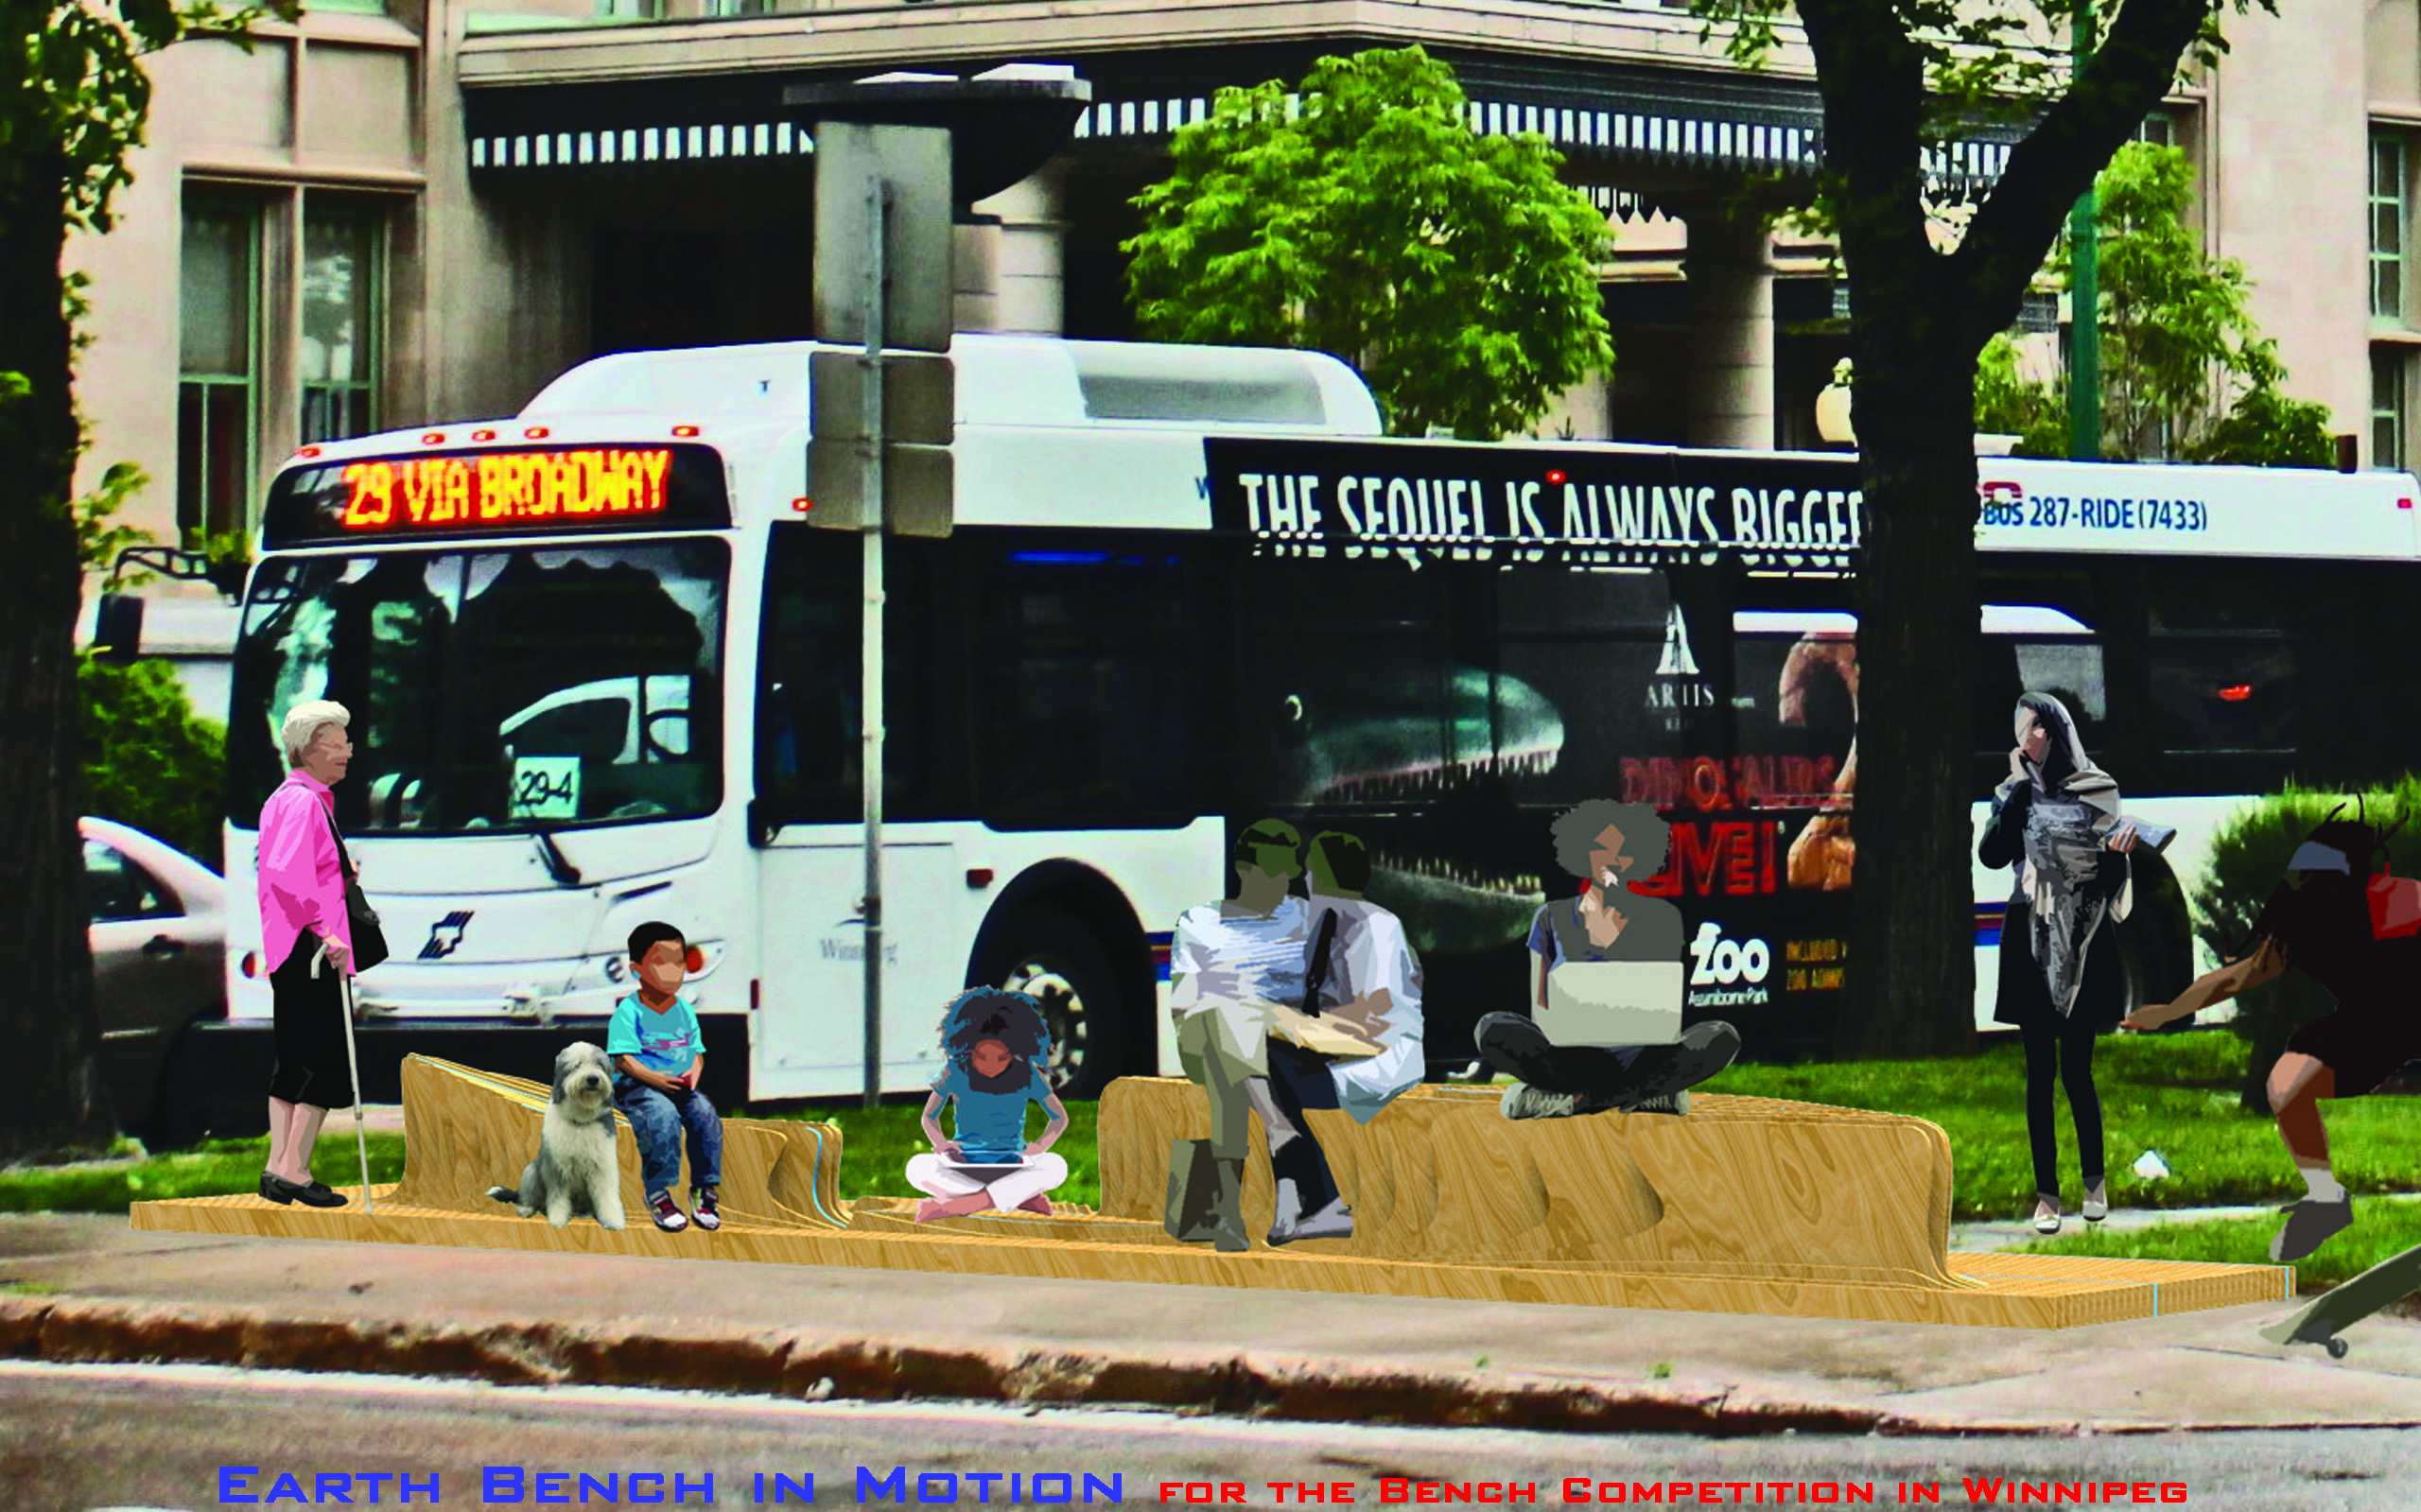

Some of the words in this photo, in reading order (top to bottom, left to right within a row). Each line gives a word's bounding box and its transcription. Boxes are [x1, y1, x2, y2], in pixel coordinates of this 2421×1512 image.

[343, 461, 392, 526] 29
[403, 458, 469, 522] VIA
[478, 449, 670, 519] BROADWAY
[1239, 473, 1327, 558] THE
[1337, 476, 1492, 571] SEQUEL
[1506, 481, 1545, 563] IS
[1562, 483, 1719, 565] ALWAYS
[2029, 496, 2134, 529] 287-RIDE
[2138, 499, 2208, 531] (7433)
[518, 770, 574, 806] 29-4
[1579, 820, 1778, 896] IVE!
